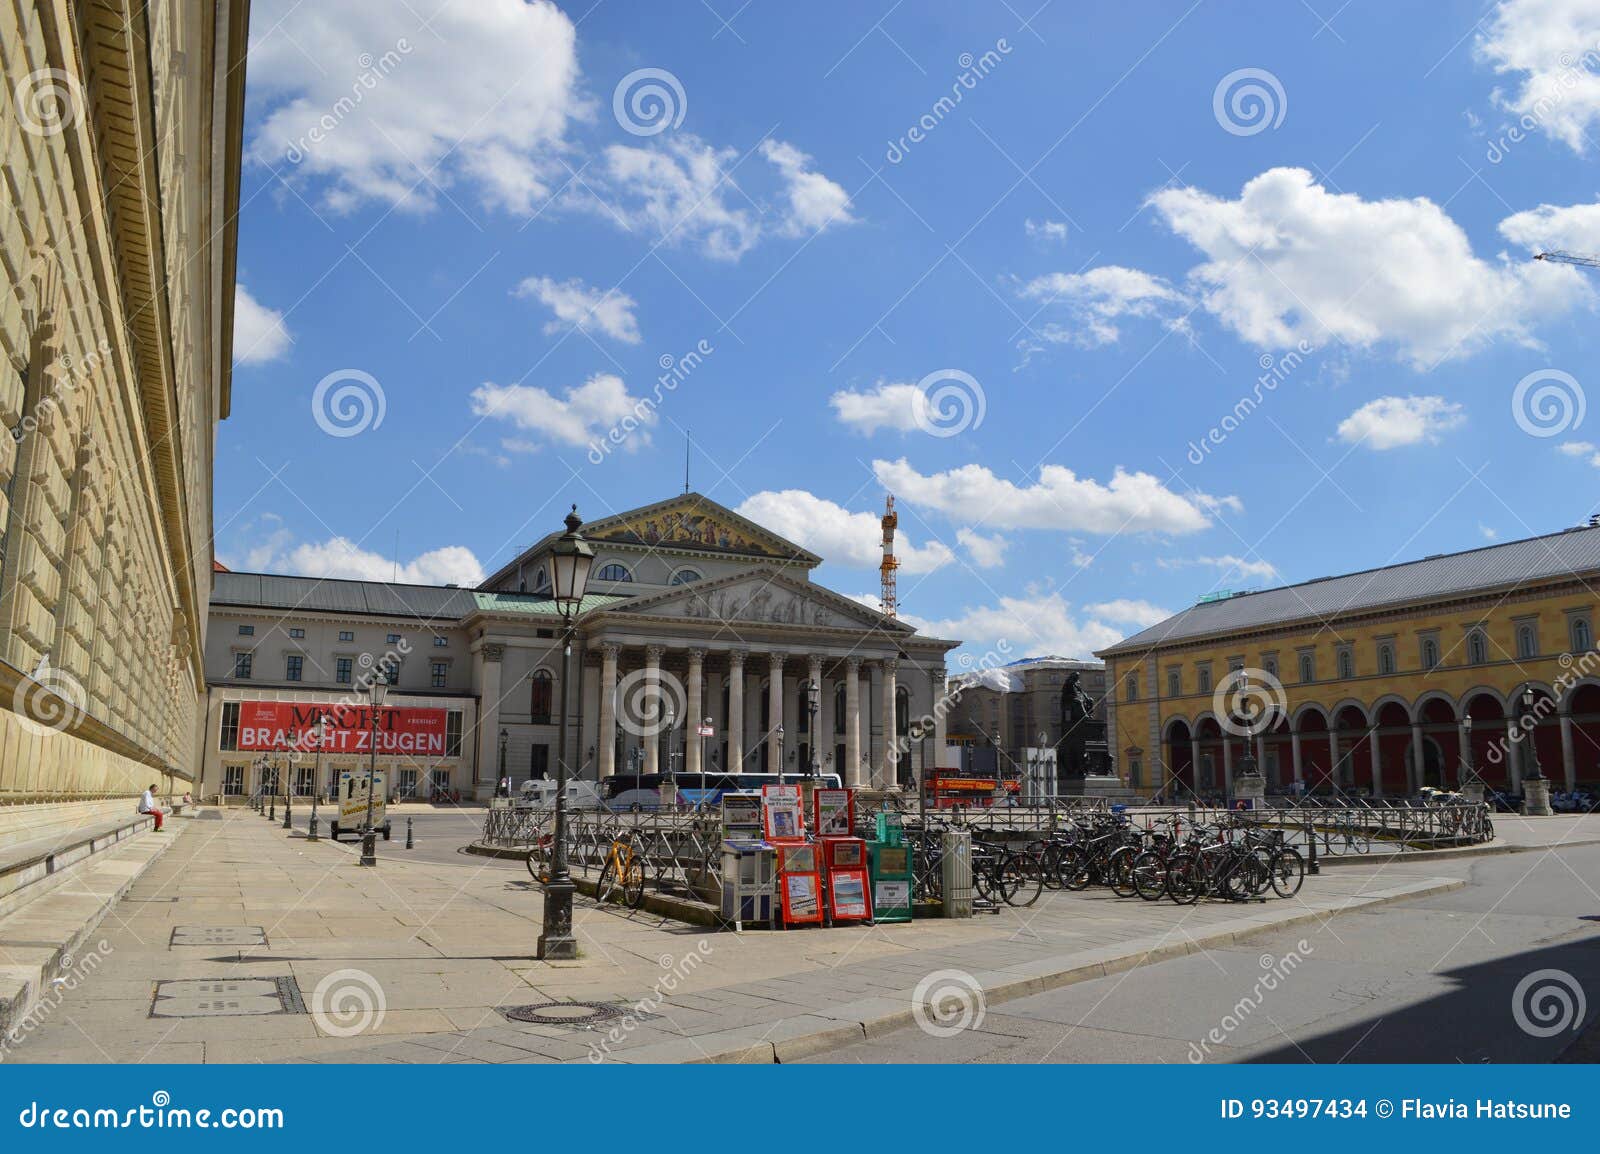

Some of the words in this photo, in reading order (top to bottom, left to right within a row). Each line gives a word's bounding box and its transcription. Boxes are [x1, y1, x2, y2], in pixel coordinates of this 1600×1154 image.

[291, 705, 400, 730] MACHT
[241, 727, 351, 749] BRAUCHT
[355, 730, 443, 751] ZEUGEN
